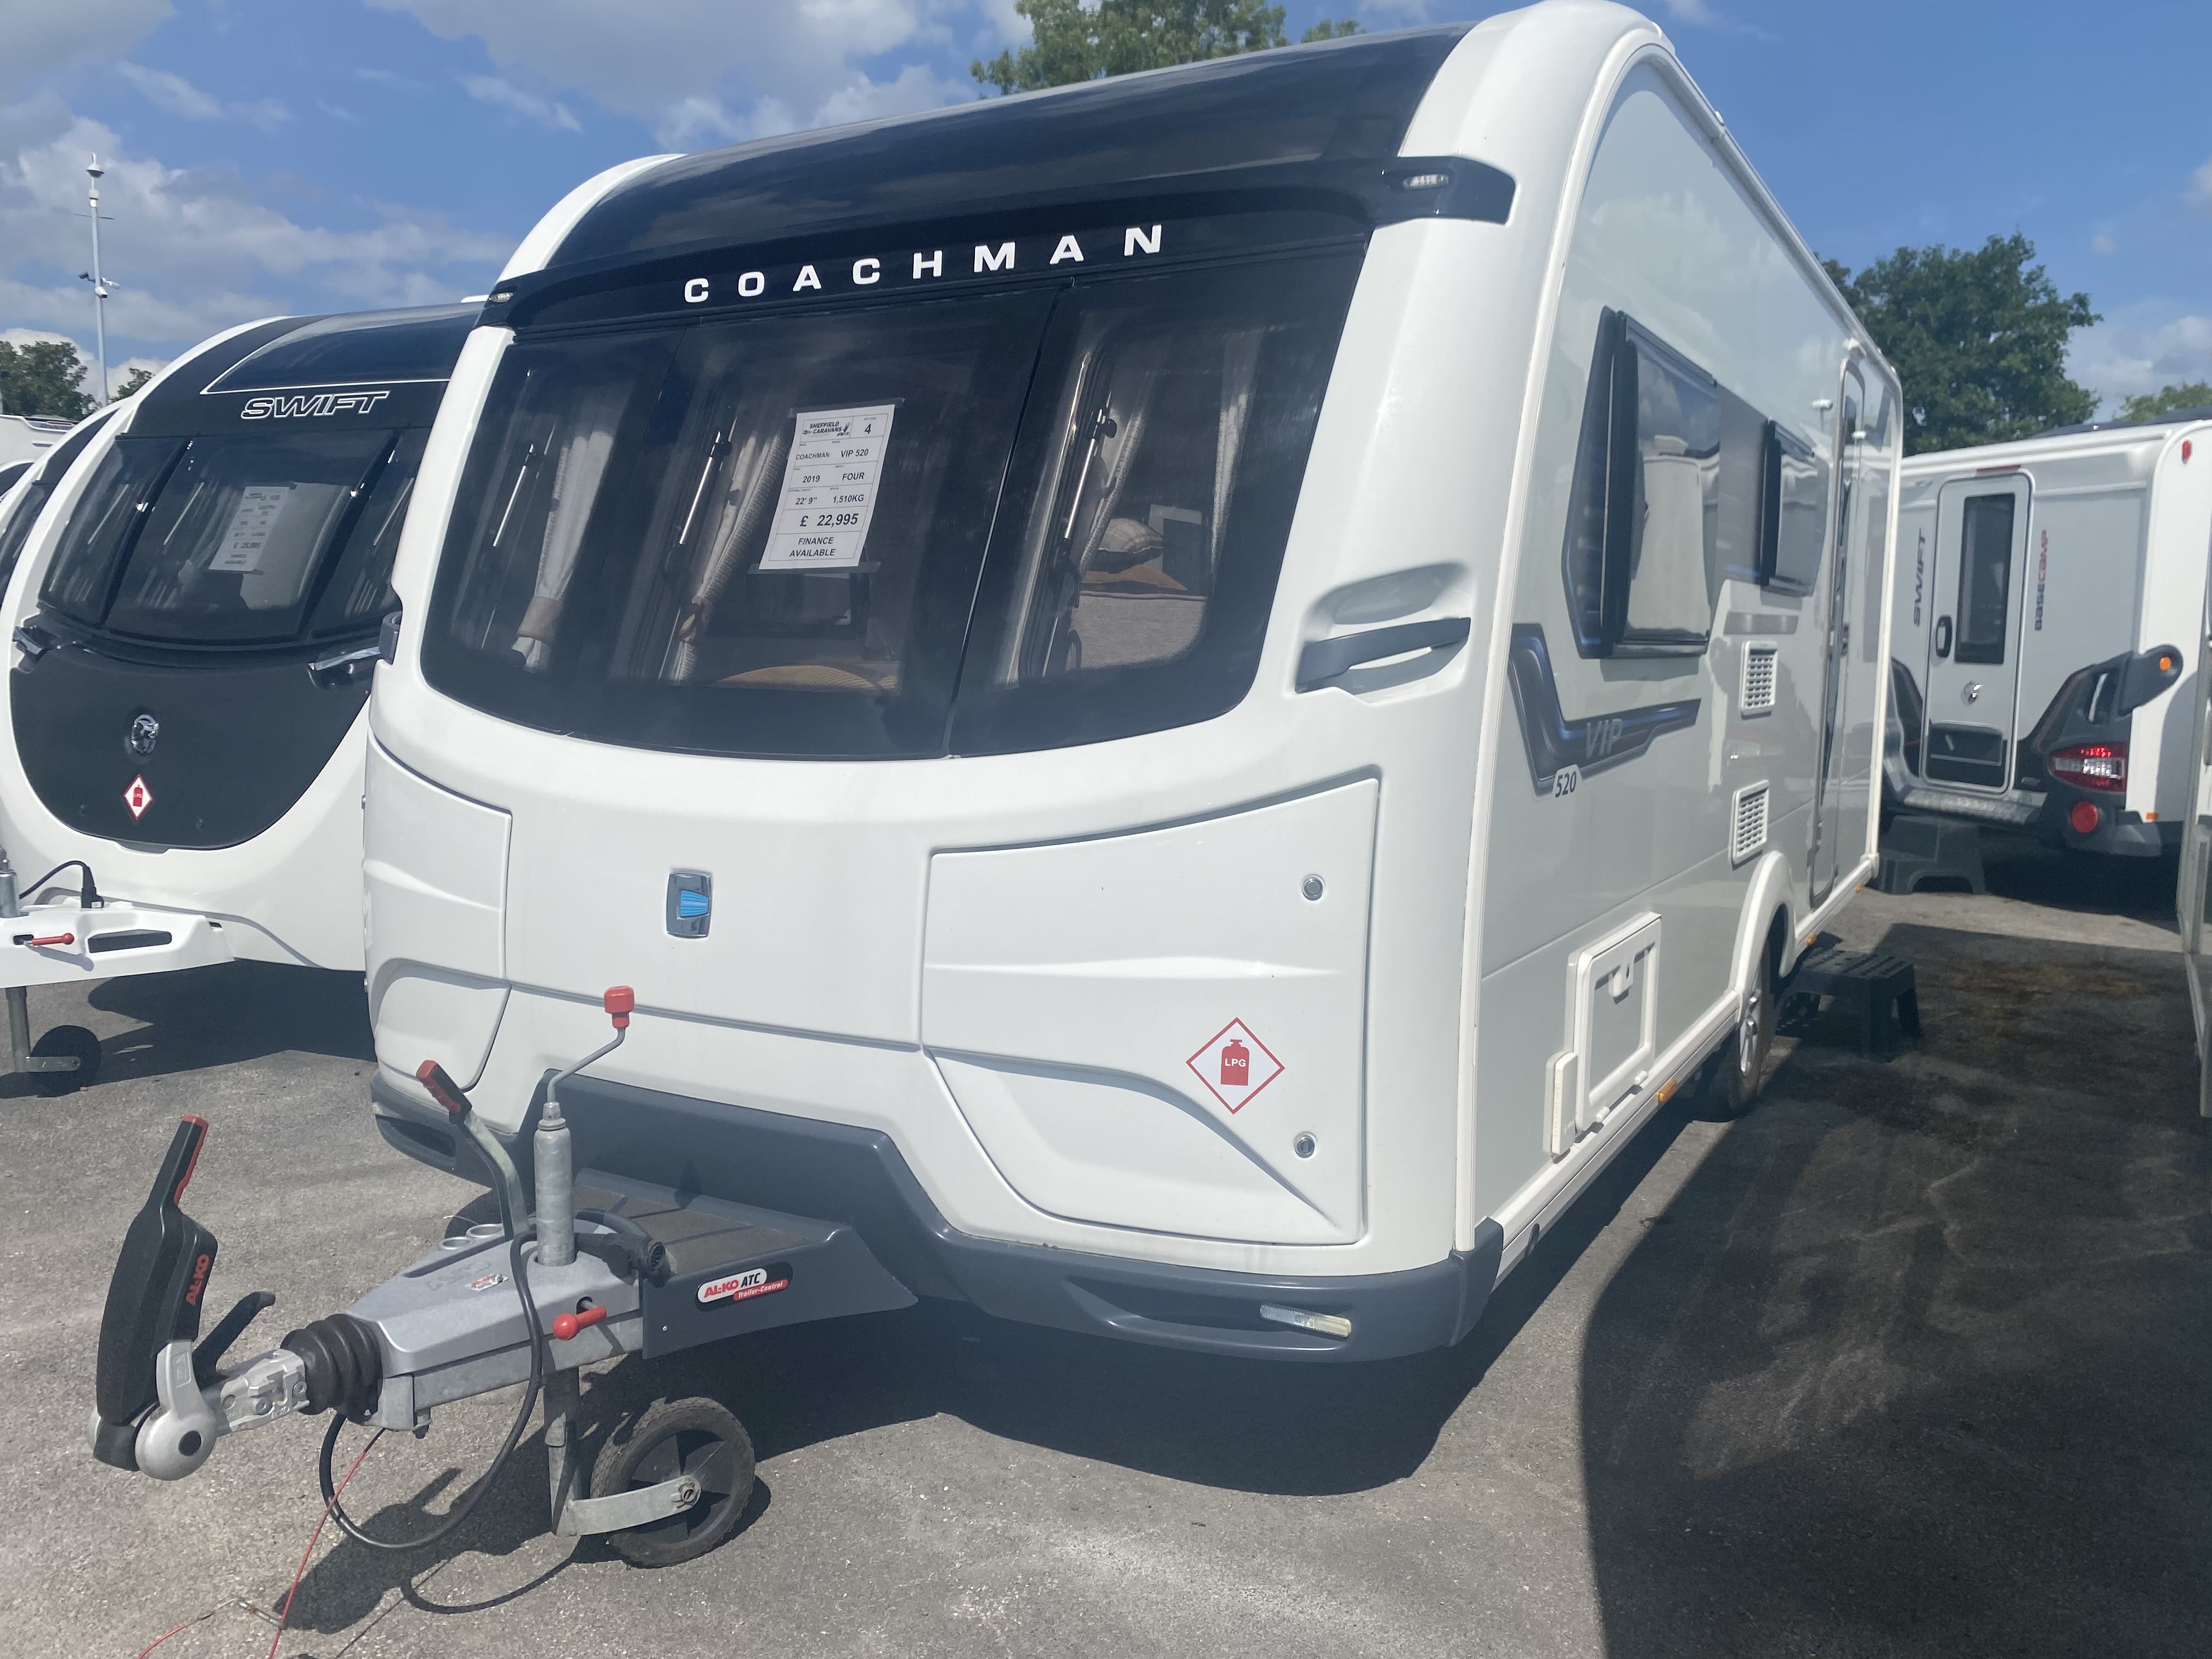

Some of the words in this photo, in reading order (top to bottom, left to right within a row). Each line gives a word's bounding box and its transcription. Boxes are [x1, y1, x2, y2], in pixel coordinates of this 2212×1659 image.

[684, 224, 1162, 303] COACHMAN
[241, 390, 391, 420] SWIFT
[864, 424, 872, 435] 4
[840, 449, 854, 458] VIP
[855, 448, 869, 456] 520
[802, 475, 820, 483] 2019
[842, 472, 865, 481] FOUR
[833, 494, 864, 504] 1,510KG
[799, 515, 809, 527] £
[817, 513, 859, 527] 22,995
[798, 537, 834, 545] FINANCE
[789, 549, 836, 557] AVAILABLE
[1913, 527, 1926, 627] SWIFT
[1585, 718, 1622, 759] VIP
[1555, 771, 1577, 798] 520
[1224, 1058, 1246, 1067] LPG
[185, 1254, 210, 1306] AL-KO
[704, 1279, 739, 1298] AL-KO
[741, 1272, 761, 1288] ATC
[737, 1281, 783, 1299] Trailer-Control
